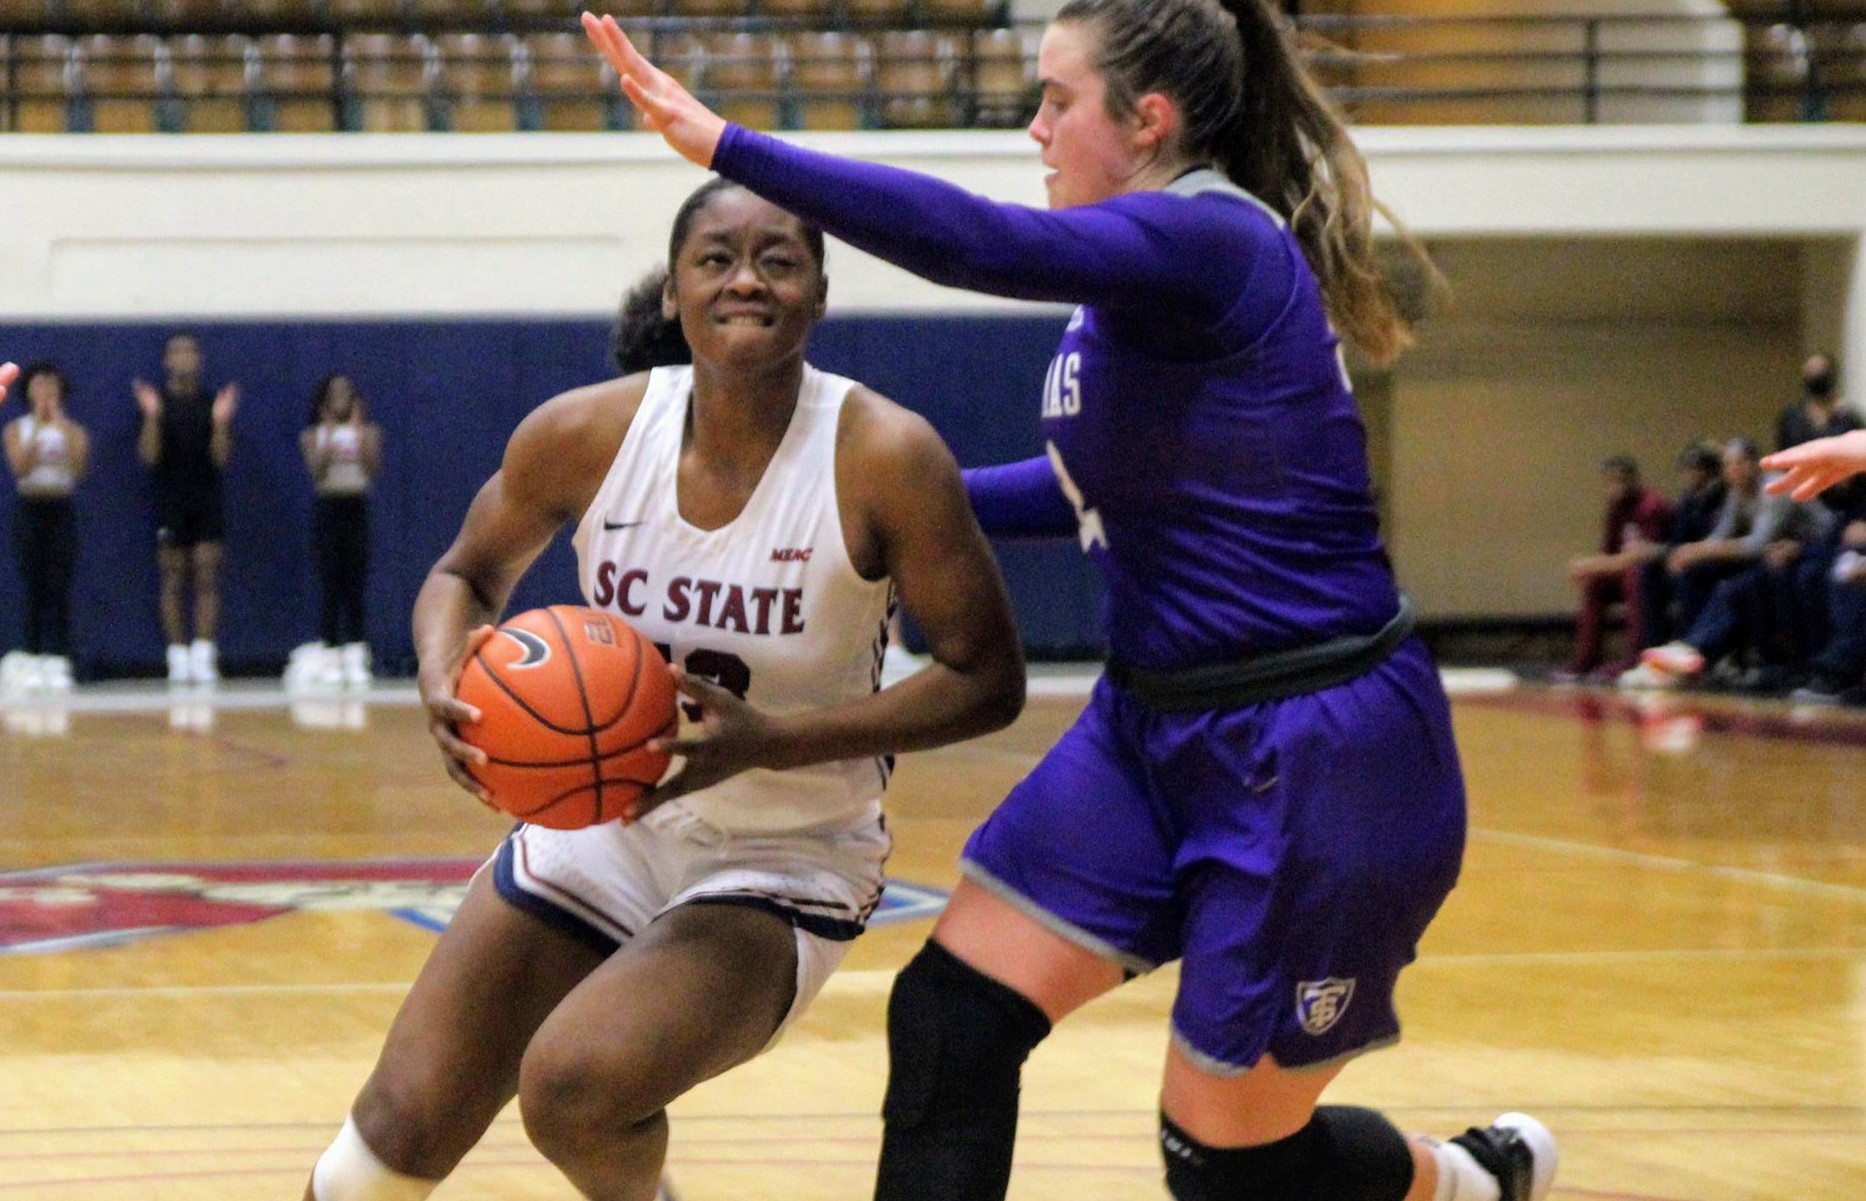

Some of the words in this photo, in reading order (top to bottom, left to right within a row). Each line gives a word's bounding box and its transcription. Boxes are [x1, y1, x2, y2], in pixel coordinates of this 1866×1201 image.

[769, 547, 813, 562] MEAC
[594, 560, 648, 616] SC
[663, 576, 805, 635] STATE
